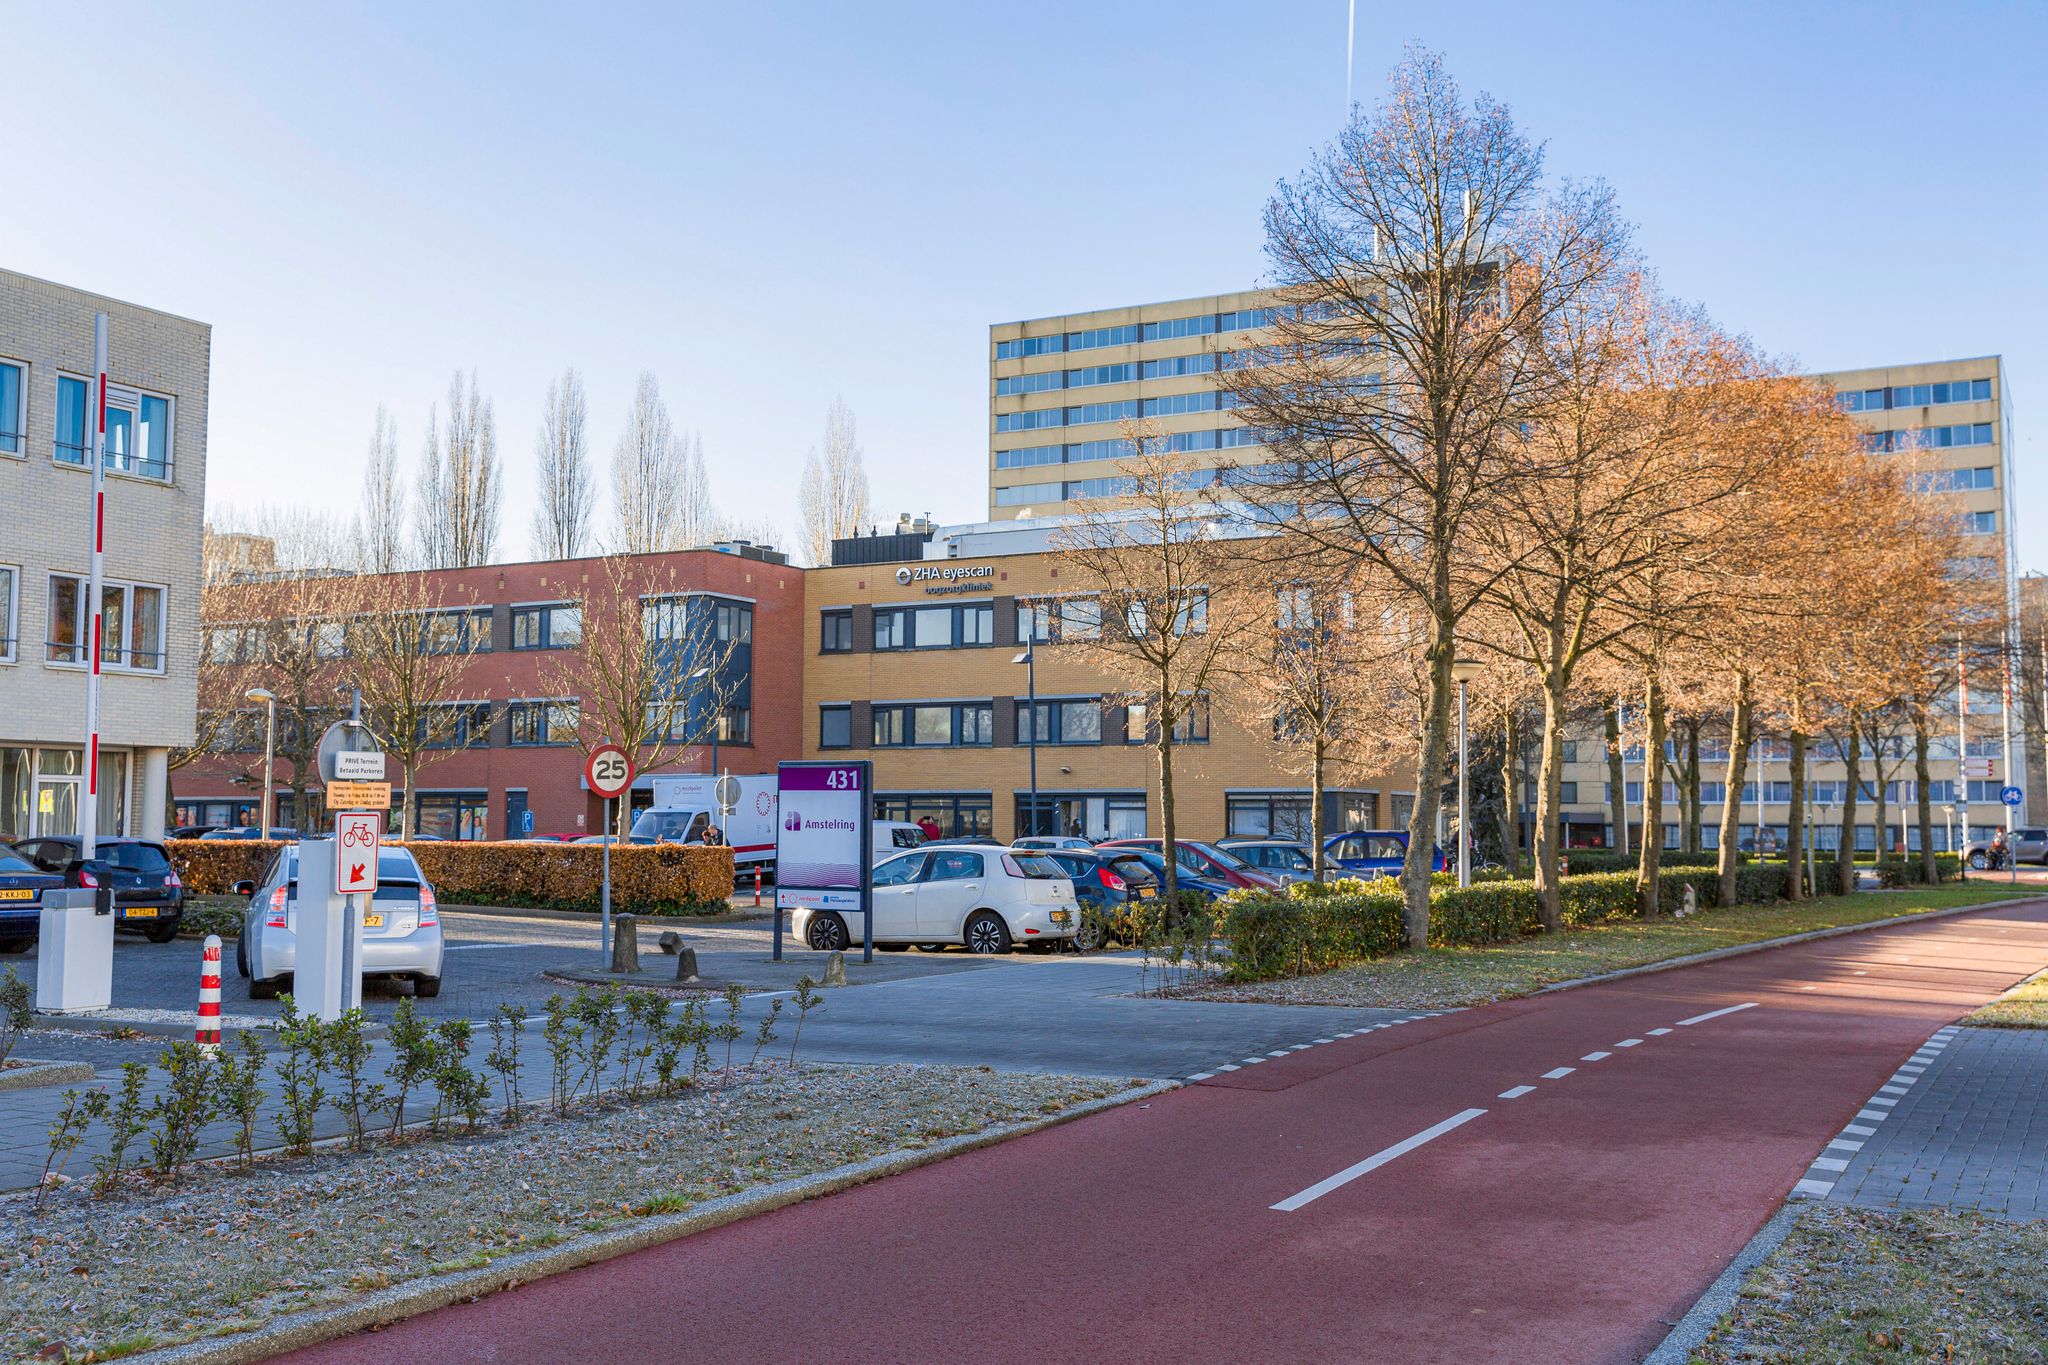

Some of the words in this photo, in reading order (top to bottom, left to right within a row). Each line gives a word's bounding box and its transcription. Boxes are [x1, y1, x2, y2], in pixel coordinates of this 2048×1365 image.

[914, 567, 940, 580] ZHA
[943, 566, 993, 581] eyescan
[596, 760, 626, 780] 25
[826, 770, 857, 789] 431
[524, 813, 531, 823] P
[805, 819, 855, 832] Amstelring
